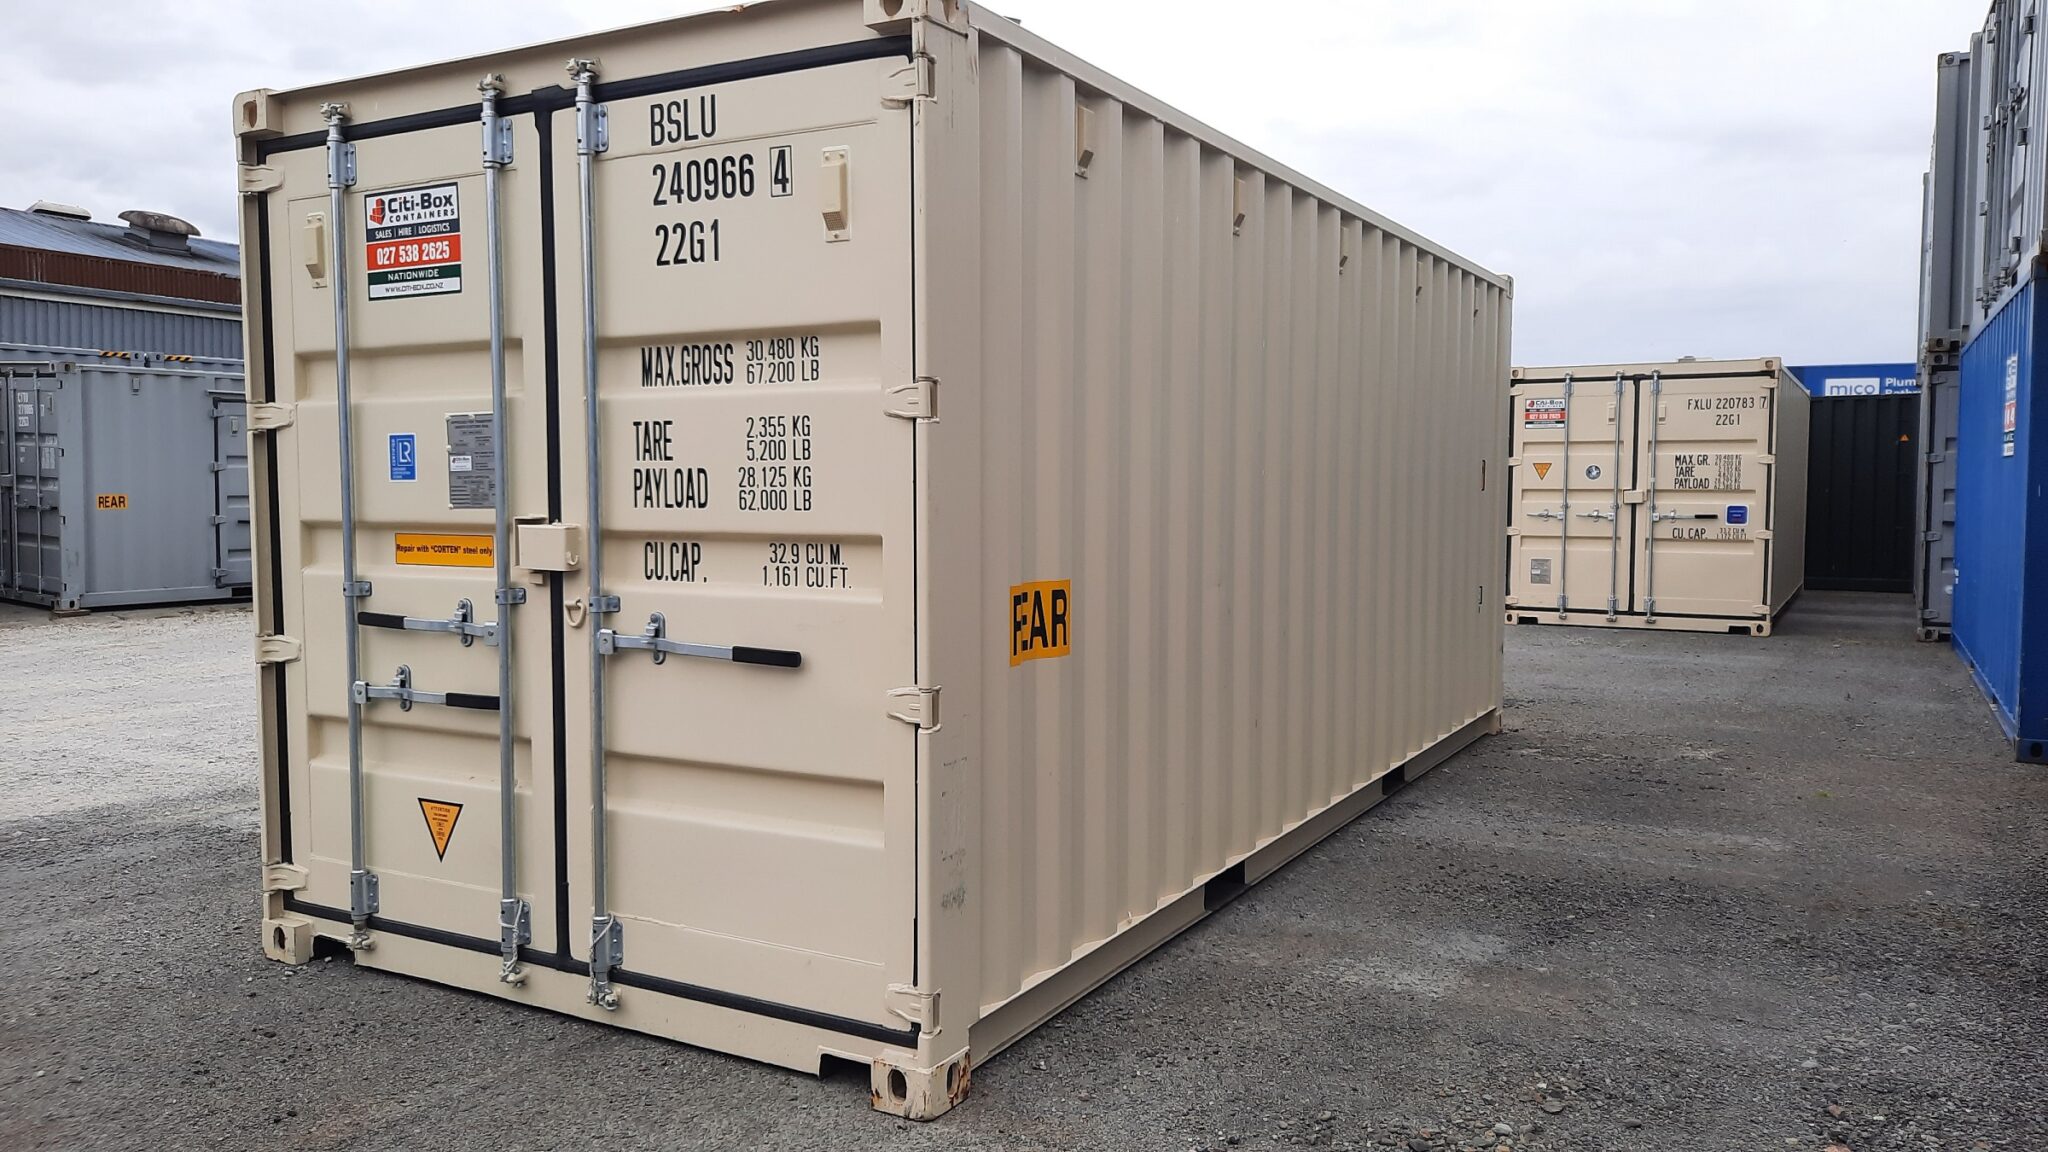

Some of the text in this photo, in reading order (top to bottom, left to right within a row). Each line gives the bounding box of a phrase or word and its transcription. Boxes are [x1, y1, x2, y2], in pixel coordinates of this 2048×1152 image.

[650, 94, 717, 147] BSLU
[652, 149, 790, 206] 240966 4
[387, 193, 454, 214] Citi-Box
[389, 208, 455, 223] CONTAINERS
[375, 223, 450, 240] SALES HIRE LOGISTICS
[655, 218, 720, 267] 22G1
[376, 241, 450, 265] 027 538 2625
[387, 269, 440, 281] NATIONWIDE
[746, 336, 820, 362] 30,480 KG
[641, 343, 734, 388] MAX.GROSS
[746, 359, 820, 385] 67,200 LB
[1830, 384, 1876, 395] mico
[1687, 396, 1767, 411] FXLU 220783 7
[746, 415, 811, 439] 2,355 KG
[1715, 413, 1740, 426] 22G1
[633, 420, 674, 462] TARE
[746, 439, 811, 462] 5,200 LB
[738, 466, 812, 488] 28,125 KG
[1674, 477, 1710, 490] PAYLOAD
[1675, 466, 1696, 478] TARE
[633, 467, 709, 509] PAYLOAD
[98, 495, 126, 509] REAR
[738, 489, 812, 512] 62,000 LB
[396, 544, 416, 553] Repair
[416, 545, 430, 553] with
[462, 546, 478, 554] steel
[479, 547, 493, 557] only
[769, 543, 845, 566] 32.9 CU.M.
[762, 566, 852, 589] 1,161 CU.FT.
